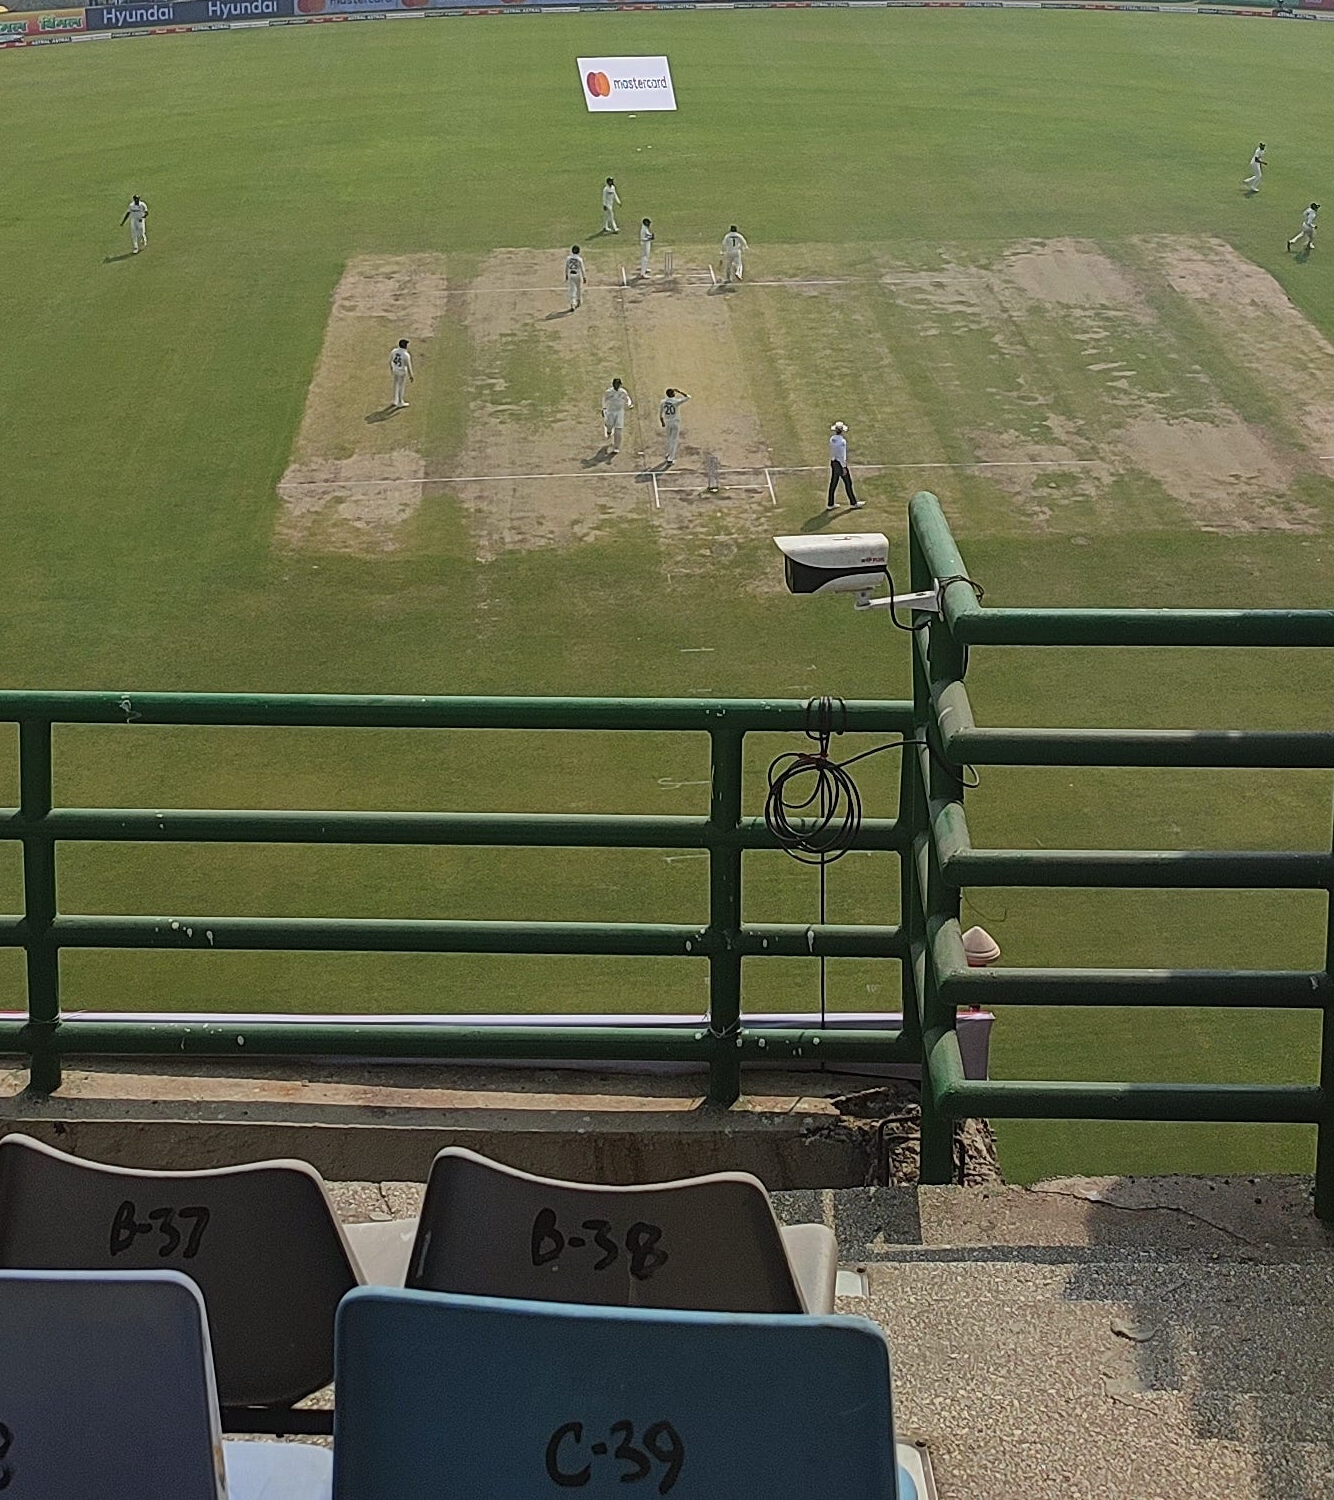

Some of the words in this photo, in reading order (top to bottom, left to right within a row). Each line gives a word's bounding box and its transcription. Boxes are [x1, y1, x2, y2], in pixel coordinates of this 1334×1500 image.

[103, 3, 173, 26] Hyundai
[613, 75, 668, 90] mastercard
[663, 405, 675, 415] 20
[109, 1200, 211, 1260] B-37
[531, 1206, 669, 1282] B-38
[544, 1419, 687, 1495] C-39
